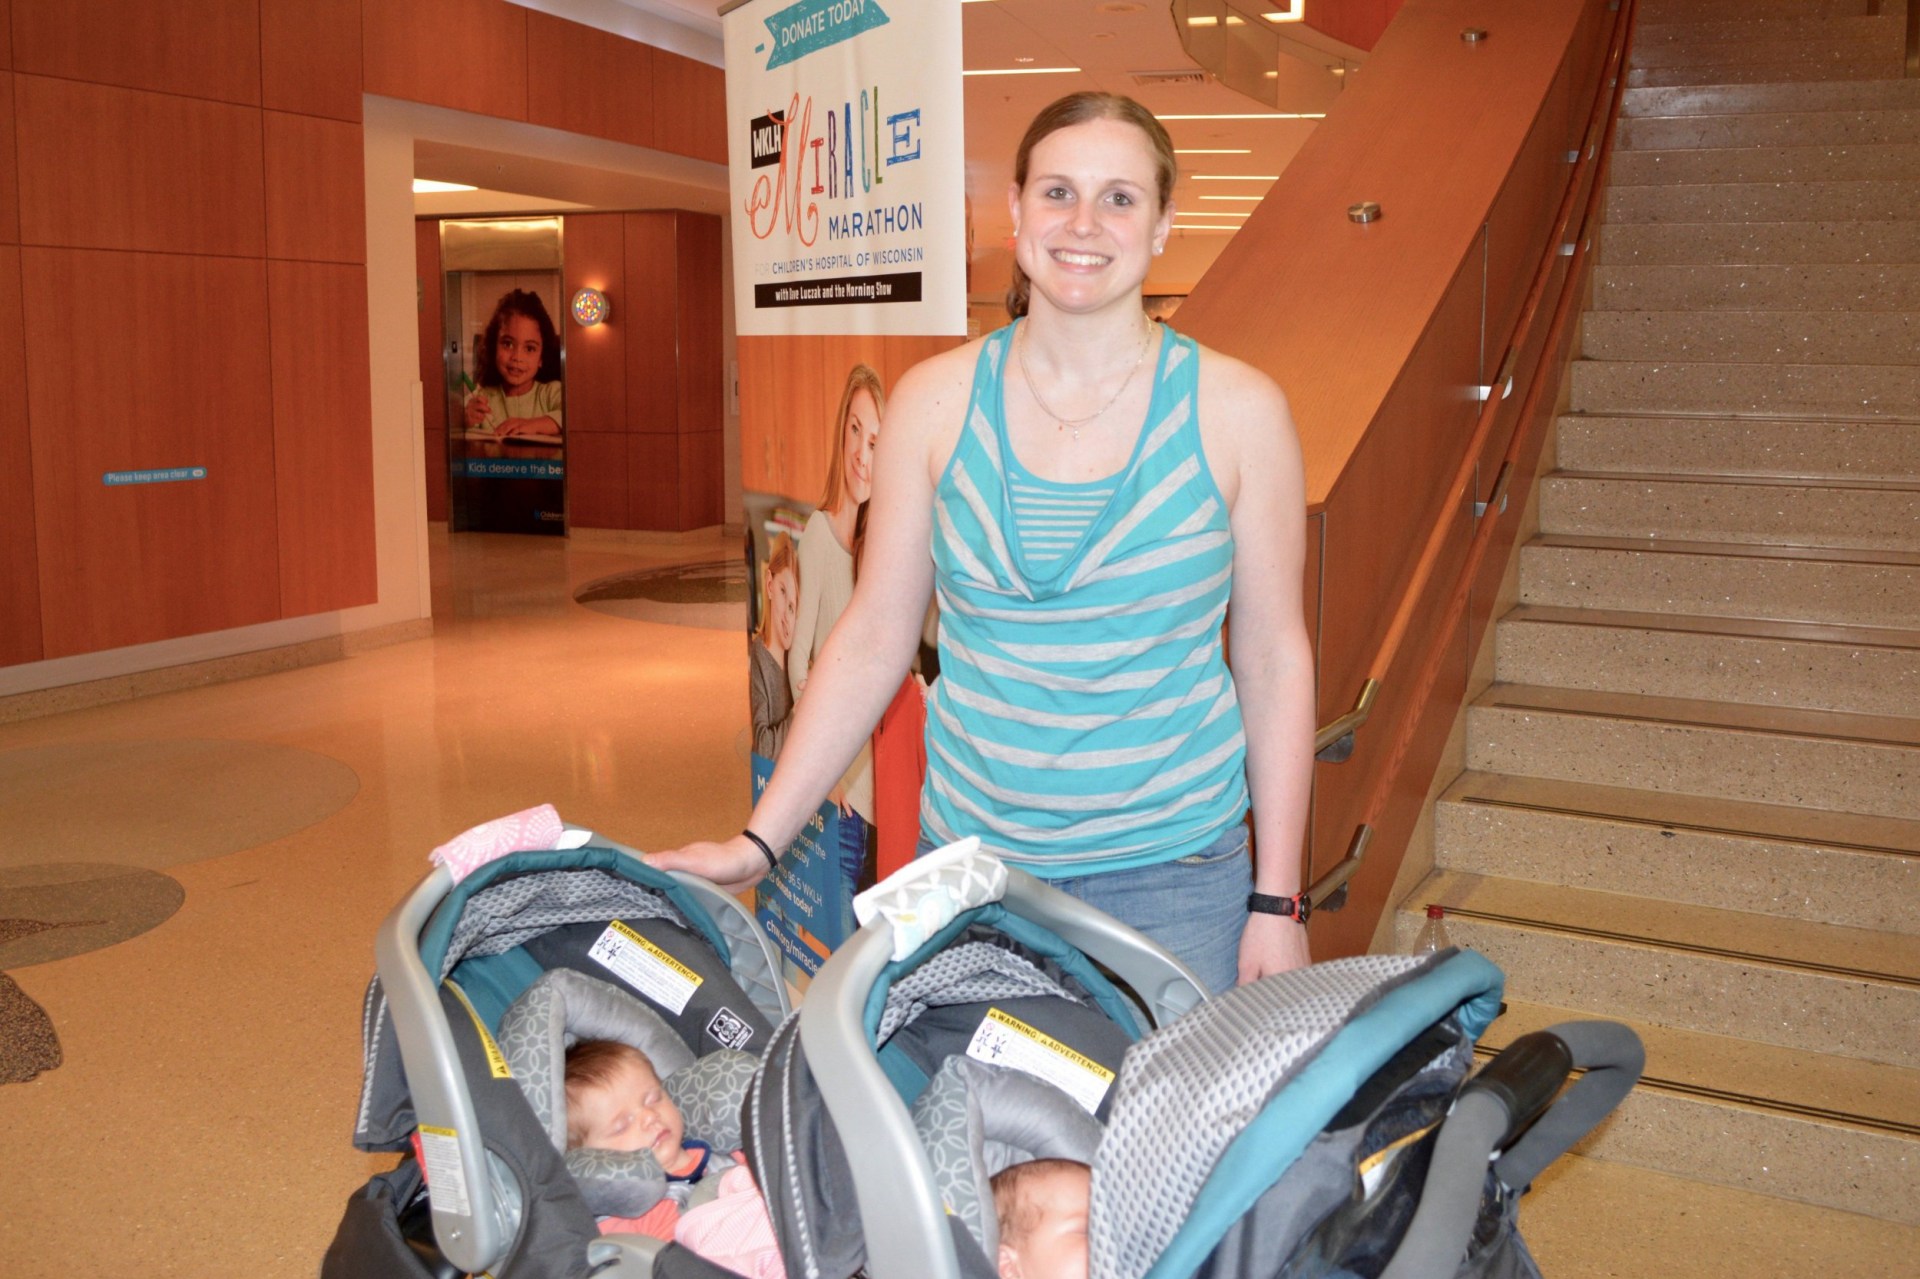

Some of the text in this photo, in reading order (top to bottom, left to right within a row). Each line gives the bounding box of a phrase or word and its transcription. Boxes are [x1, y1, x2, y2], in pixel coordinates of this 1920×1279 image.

[782, 0, 865, 47] DONATE TODAY
[753, 124, 782, 158] WKLH
[745, 86, 921, 247] MIRACLE
[829, 202, 922, 240] MARATHON
[772, 257, 813, 275] CHILDREN'S
[816, 254, 852, 270] HOSPITAL
[856, 252, 870, 267] OF
[873, 247, 923, 265] WISCONSIN
[822, 284, 834, 299] and
[835, 283, 846, 298] the
[846, 283, 875, 300] Morning
[876, 281, 892, 296] Show
[108, 469, 188, 483] Please keep area clear
[468, 462, 487, 473] Kids
[488, 463, 528, 474] deserve
[530, 464, 546, 474] the
[617, 925, 698, 983] WARNING ADVERTENCIA
[998, 1014, 1037, 1039] WARNING
[1048, 1041, 1108, 1079] ADVERTENCIA
